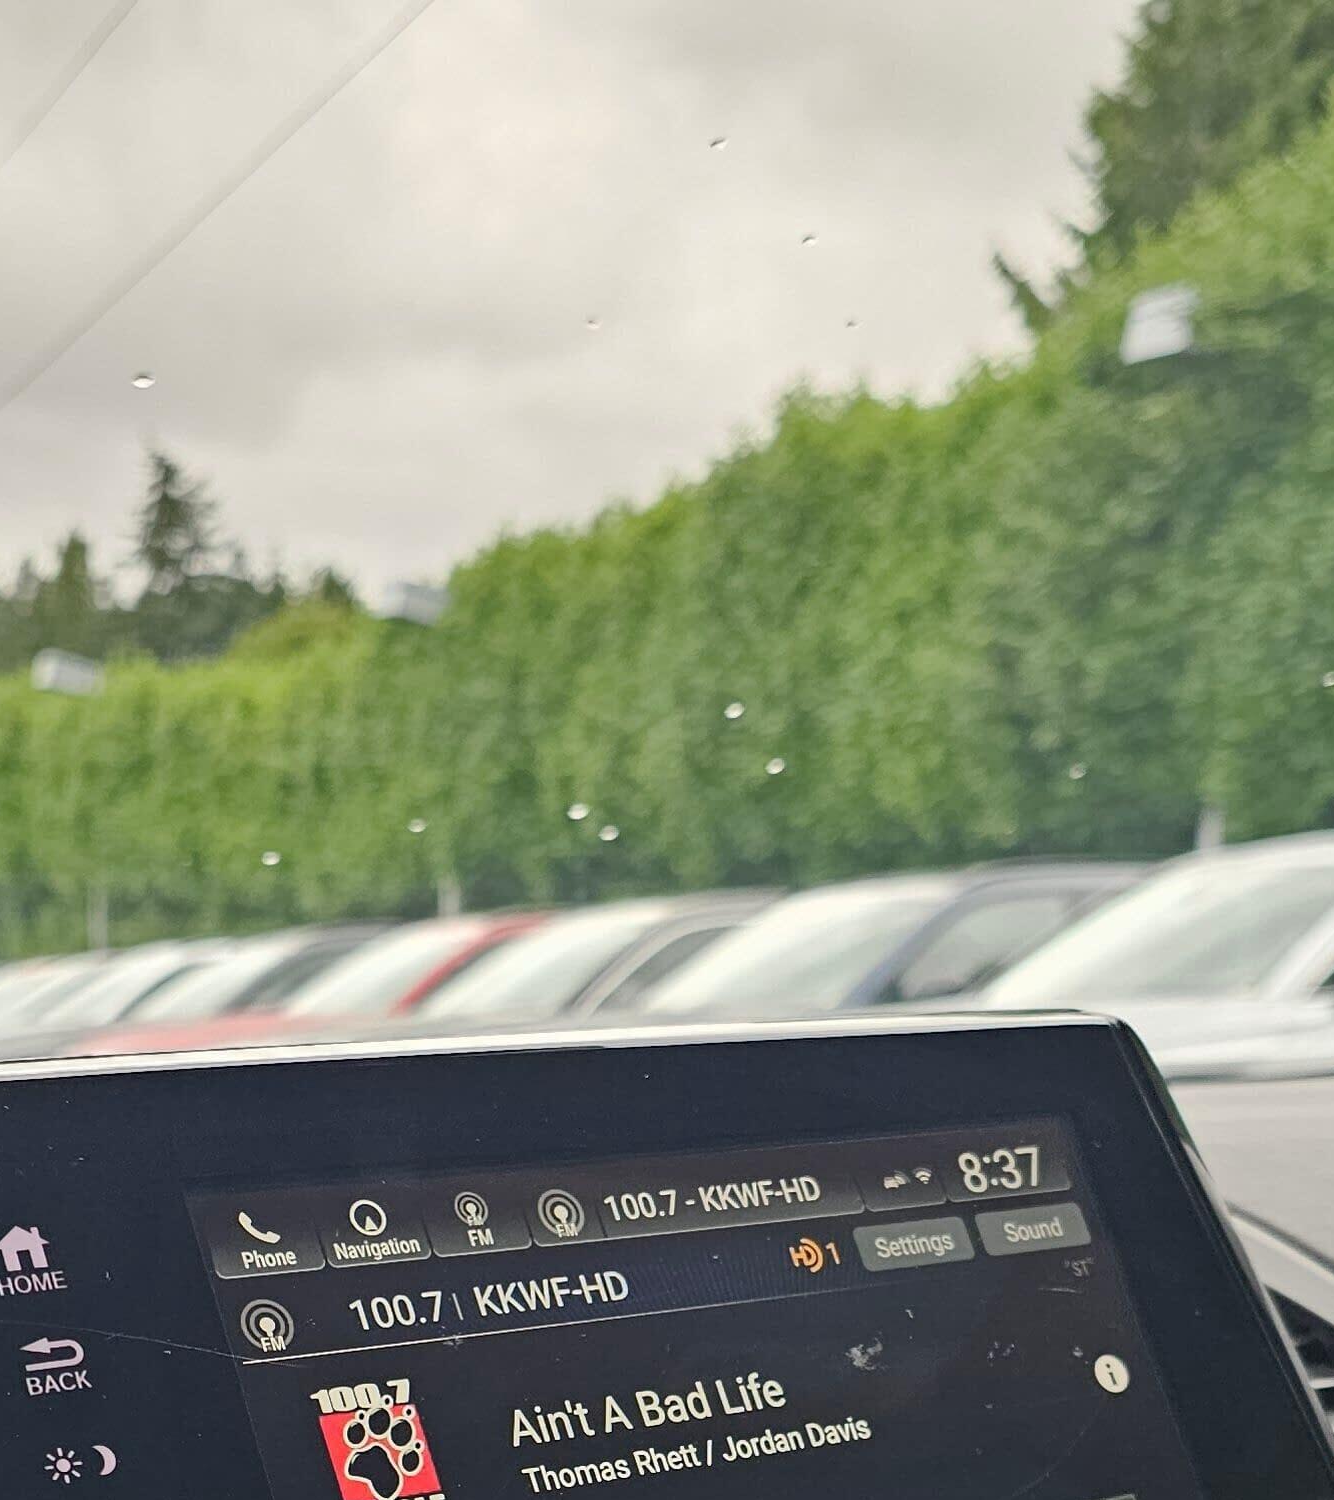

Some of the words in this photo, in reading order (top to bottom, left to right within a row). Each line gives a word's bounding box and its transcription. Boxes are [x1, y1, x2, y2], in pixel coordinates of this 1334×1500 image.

[958, 1146, 1040, 1193] 8:37
[604, 1190, 676, 1222] 100.7
[698, 1175, 821, 1212] KKWF-HD
[468, 1228, 494, 1247] FM
[1004, 1216, 1063, 1244] Sound
[241, 1248, 297, 1269] Phone
[334, 1236, 421, 1262] Navigation
[825, 1242, 840, 1265] 1
[874, 1232, 955, 1260] Settings
[348, 1291, 443, 1331] 100.7
[473, 1270, 629, 1317] KKWF-HD
[261, 1334, 287, 1354] FM
[25, 1370, 92, 1396] BACK
[310, 1379, 412, 1414] 100.7
[511, 1396, 596, 1448] Ain't
[602, 1397, 634, 1434] A
[639, 1380, 712, 1428] Bad
[717, 1371, 786, 1414] Life
[521, 1459, 630, 1495] Thomas
[634, 1443, 702, 1474] Rhett
[722, 1427, 808, 1466] Jordan
[807, 1416, 871, 1448] Davis
